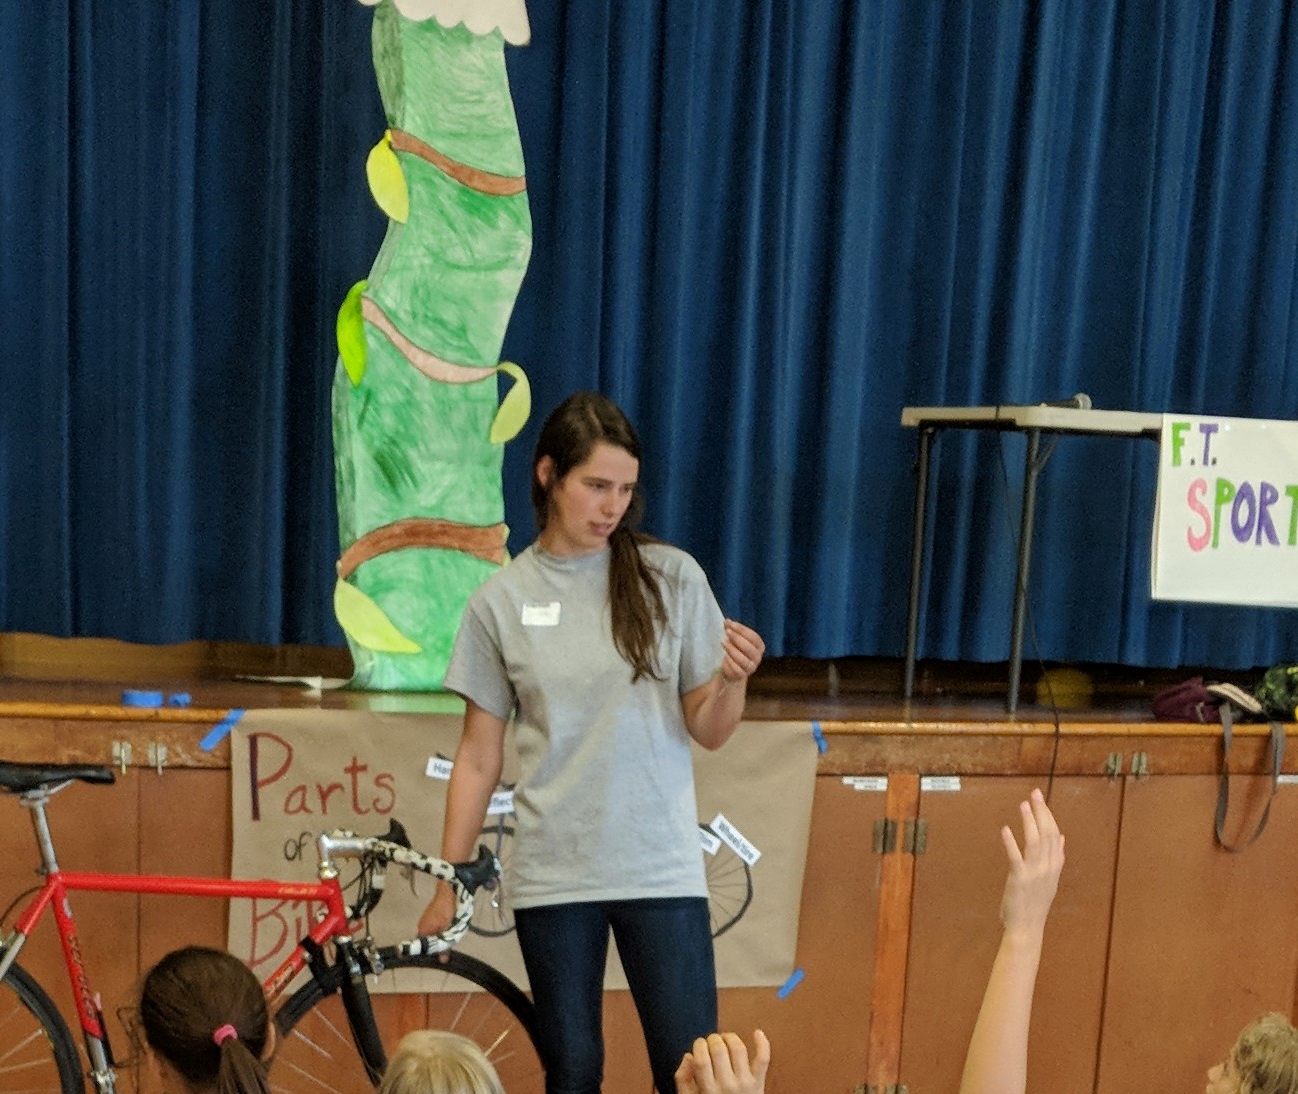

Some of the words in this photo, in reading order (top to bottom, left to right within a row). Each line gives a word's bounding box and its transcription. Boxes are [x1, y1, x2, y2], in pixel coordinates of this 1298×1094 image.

[1171, 422, 1220, 467] F.T.
[248, 732, 397, 822] Parts
[283, 831, 313, 861] of
